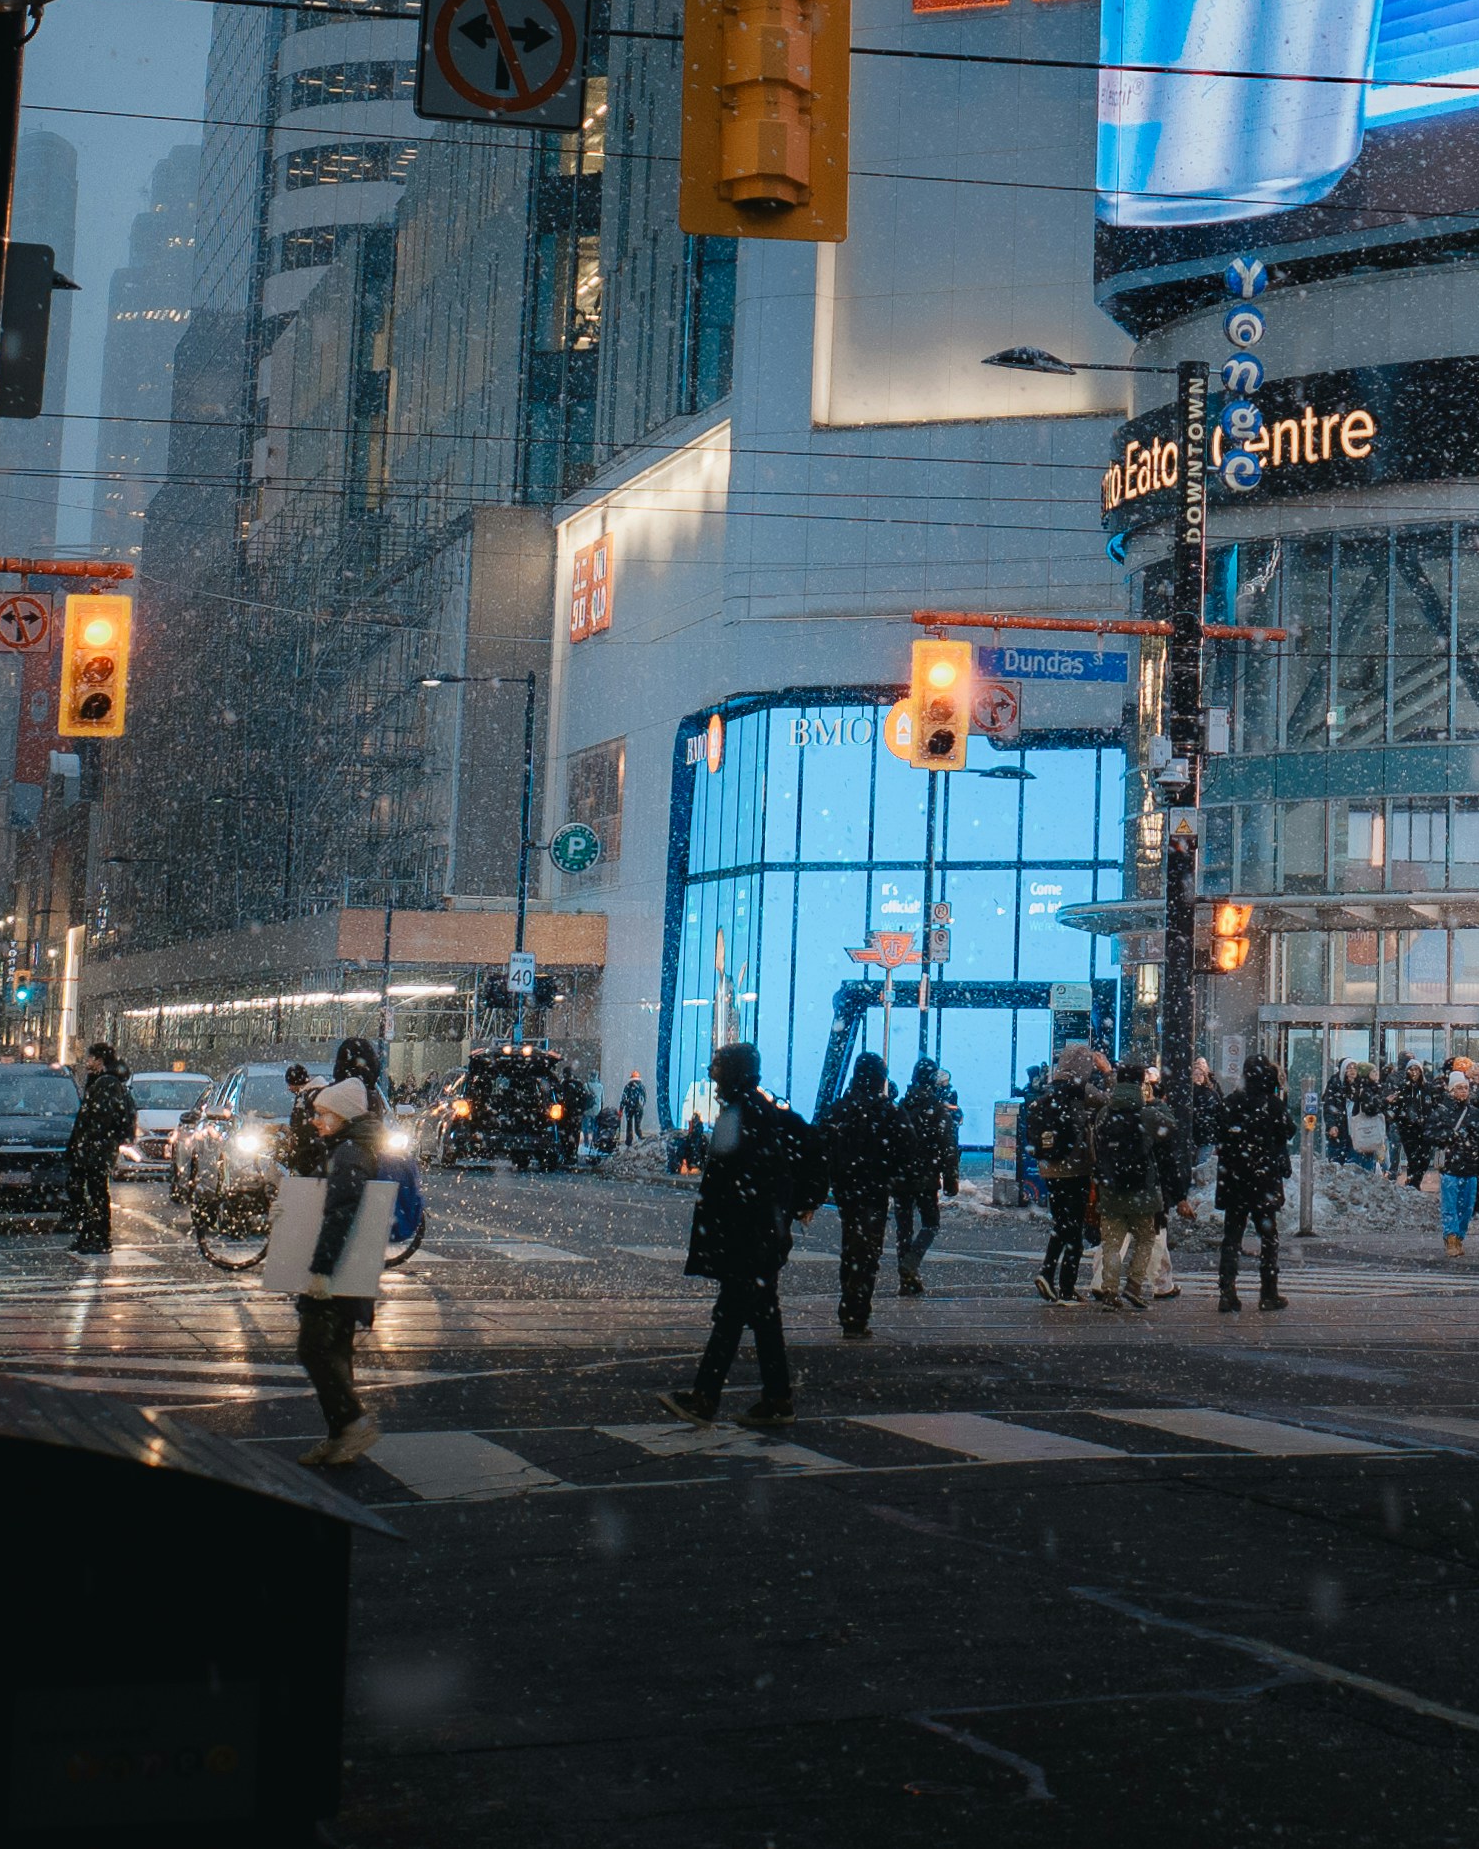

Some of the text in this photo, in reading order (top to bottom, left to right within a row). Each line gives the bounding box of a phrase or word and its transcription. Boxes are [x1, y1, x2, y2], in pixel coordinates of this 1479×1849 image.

[1124, 436, 1179, 501] Eato
[1186, 377, 1206, 545] DOWNTOWN
[1005, 650, 1083, 675] Dundas
[787, 718, 875, 747] BMO
[687, 734, 707, 765] BMO
[568, 837, 585, 856] P
[881, 883, 898, 896] It's
[1029, 882, 1063, 896] Come
[511, 969, 533, 987] 40
